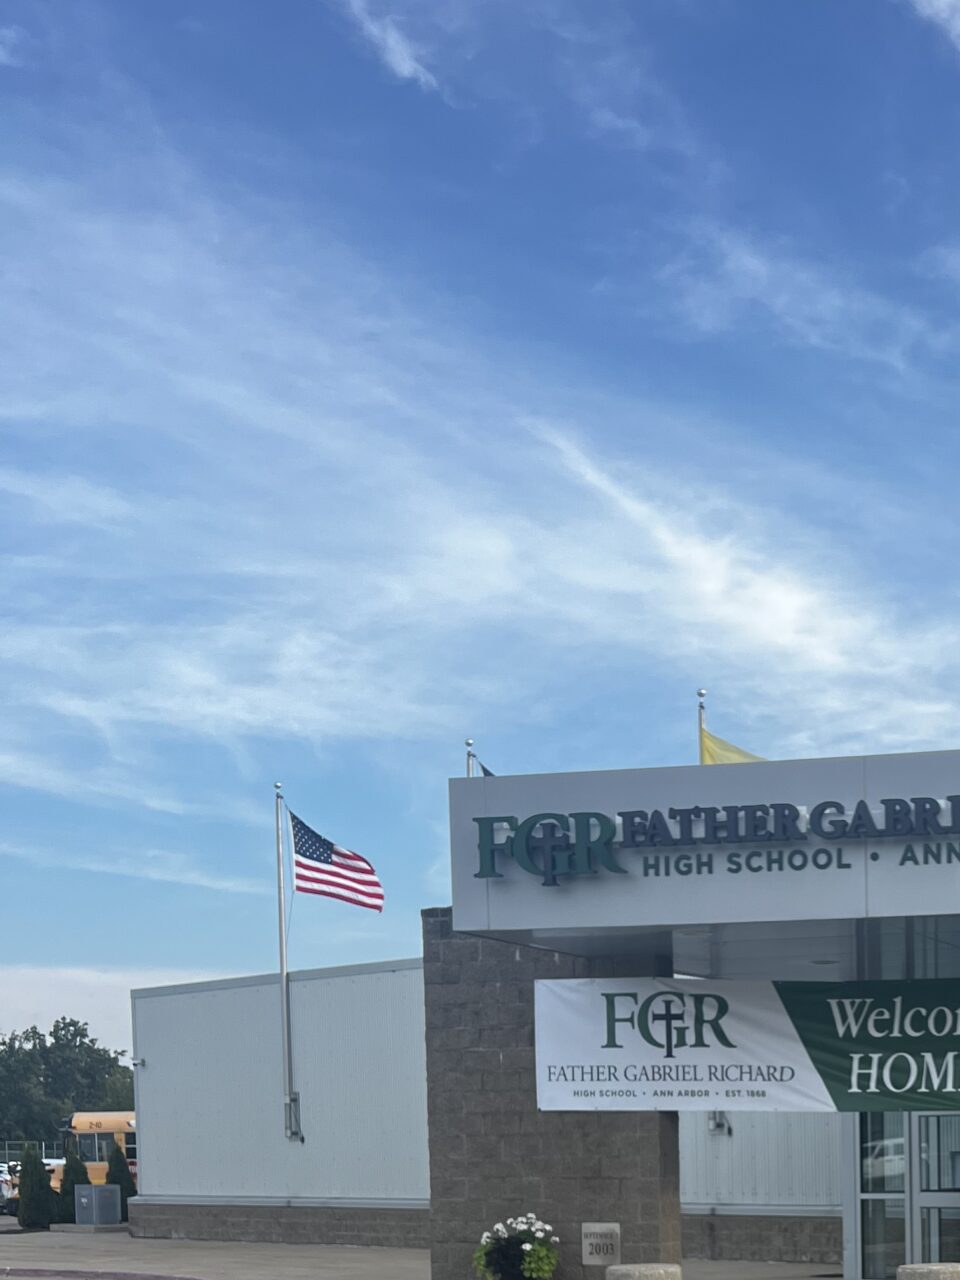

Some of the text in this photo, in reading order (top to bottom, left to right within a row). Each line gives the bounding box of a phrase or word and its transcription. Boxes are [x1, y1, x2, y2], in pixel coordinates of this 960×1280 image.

[618, 803, 806, 848] FATHER
[473, 812, 628, 886] FGR
[643, 852, 715, 877] HIGH
[727, 847, 852, 873] SCHOOL
[600, 991, 738, 1059] FGR
[547, 1064, 796, 1083] FATHER GABRIEL RICHARD
[573, 1089, 596, 1098] HIGH
[599, 1089, 637, 1098] SCHOOL
[652, 1089, 674, 1098] ANN
[677, 1089, 710, 1098] ARBOR
[746, 1089, 767, 1098] 1868
[588, 1242, 615, 1256] 2003
